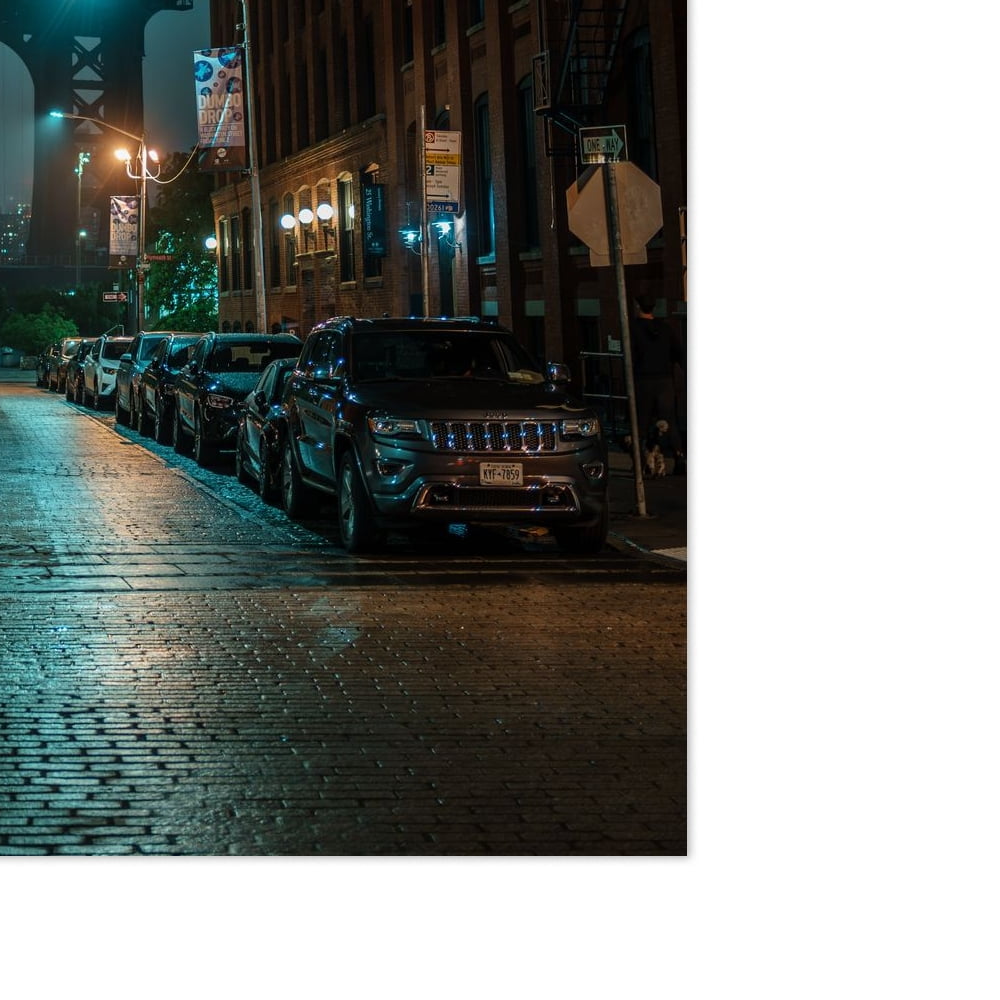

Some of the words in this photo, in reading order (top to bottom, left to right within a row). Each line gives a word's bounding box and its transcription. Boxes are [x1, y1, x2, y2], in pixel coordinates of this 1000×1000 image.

[198, 92, 241, 110] DUMBO
[199, 109, 232, 125] DROP
[586, 138, 600, 152] ONE
[605, 137, 619, 152] WAY
